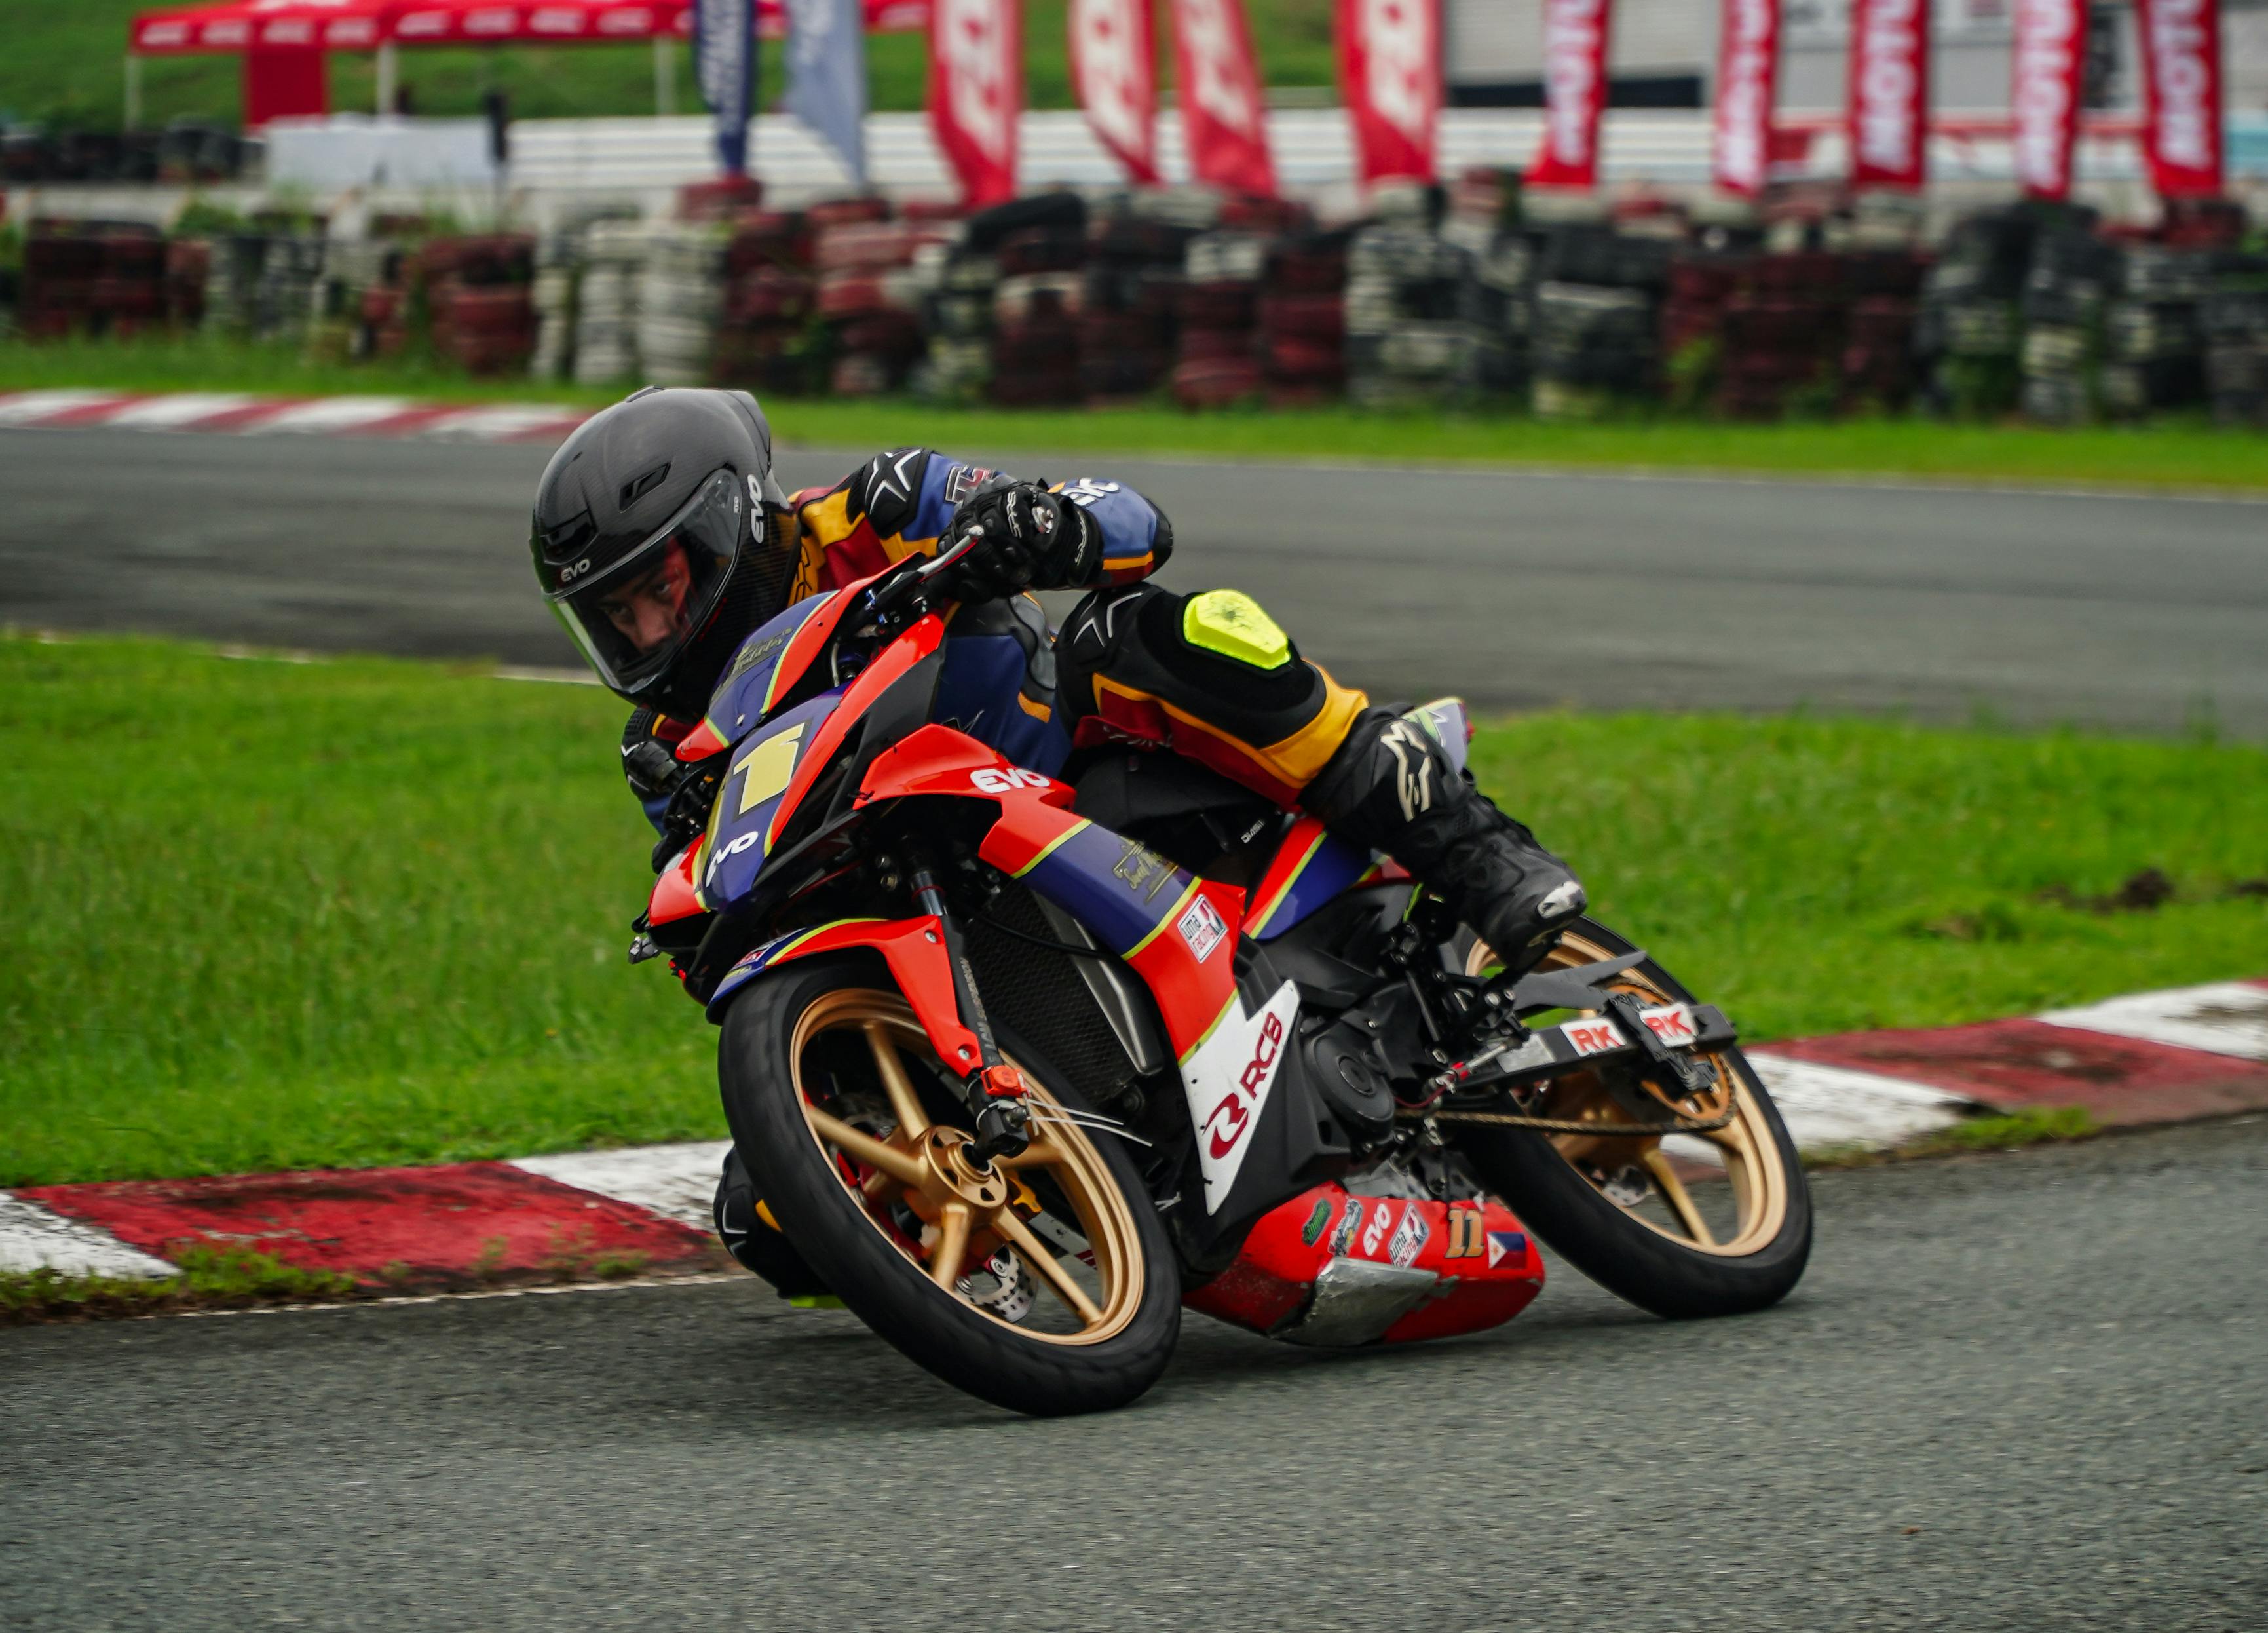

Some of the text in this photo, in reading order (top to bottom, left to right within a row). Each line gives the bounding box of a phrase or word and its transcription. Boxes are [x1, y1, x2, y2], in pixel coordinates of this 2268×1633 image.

[747, 474, 764, 543] EVO
[561, 559, 590, 582] EVO
[970, 768, 1051, 794] EVO
[1570, 1025, 1623, 1051] RK
[1645, 1010, 1693, 1045] RK
[1239, 1011, 1282, 1101] RCB
[1363, 1203, 1391, 1256] EVO
[1444, 1209, 1485, 1258] 11
